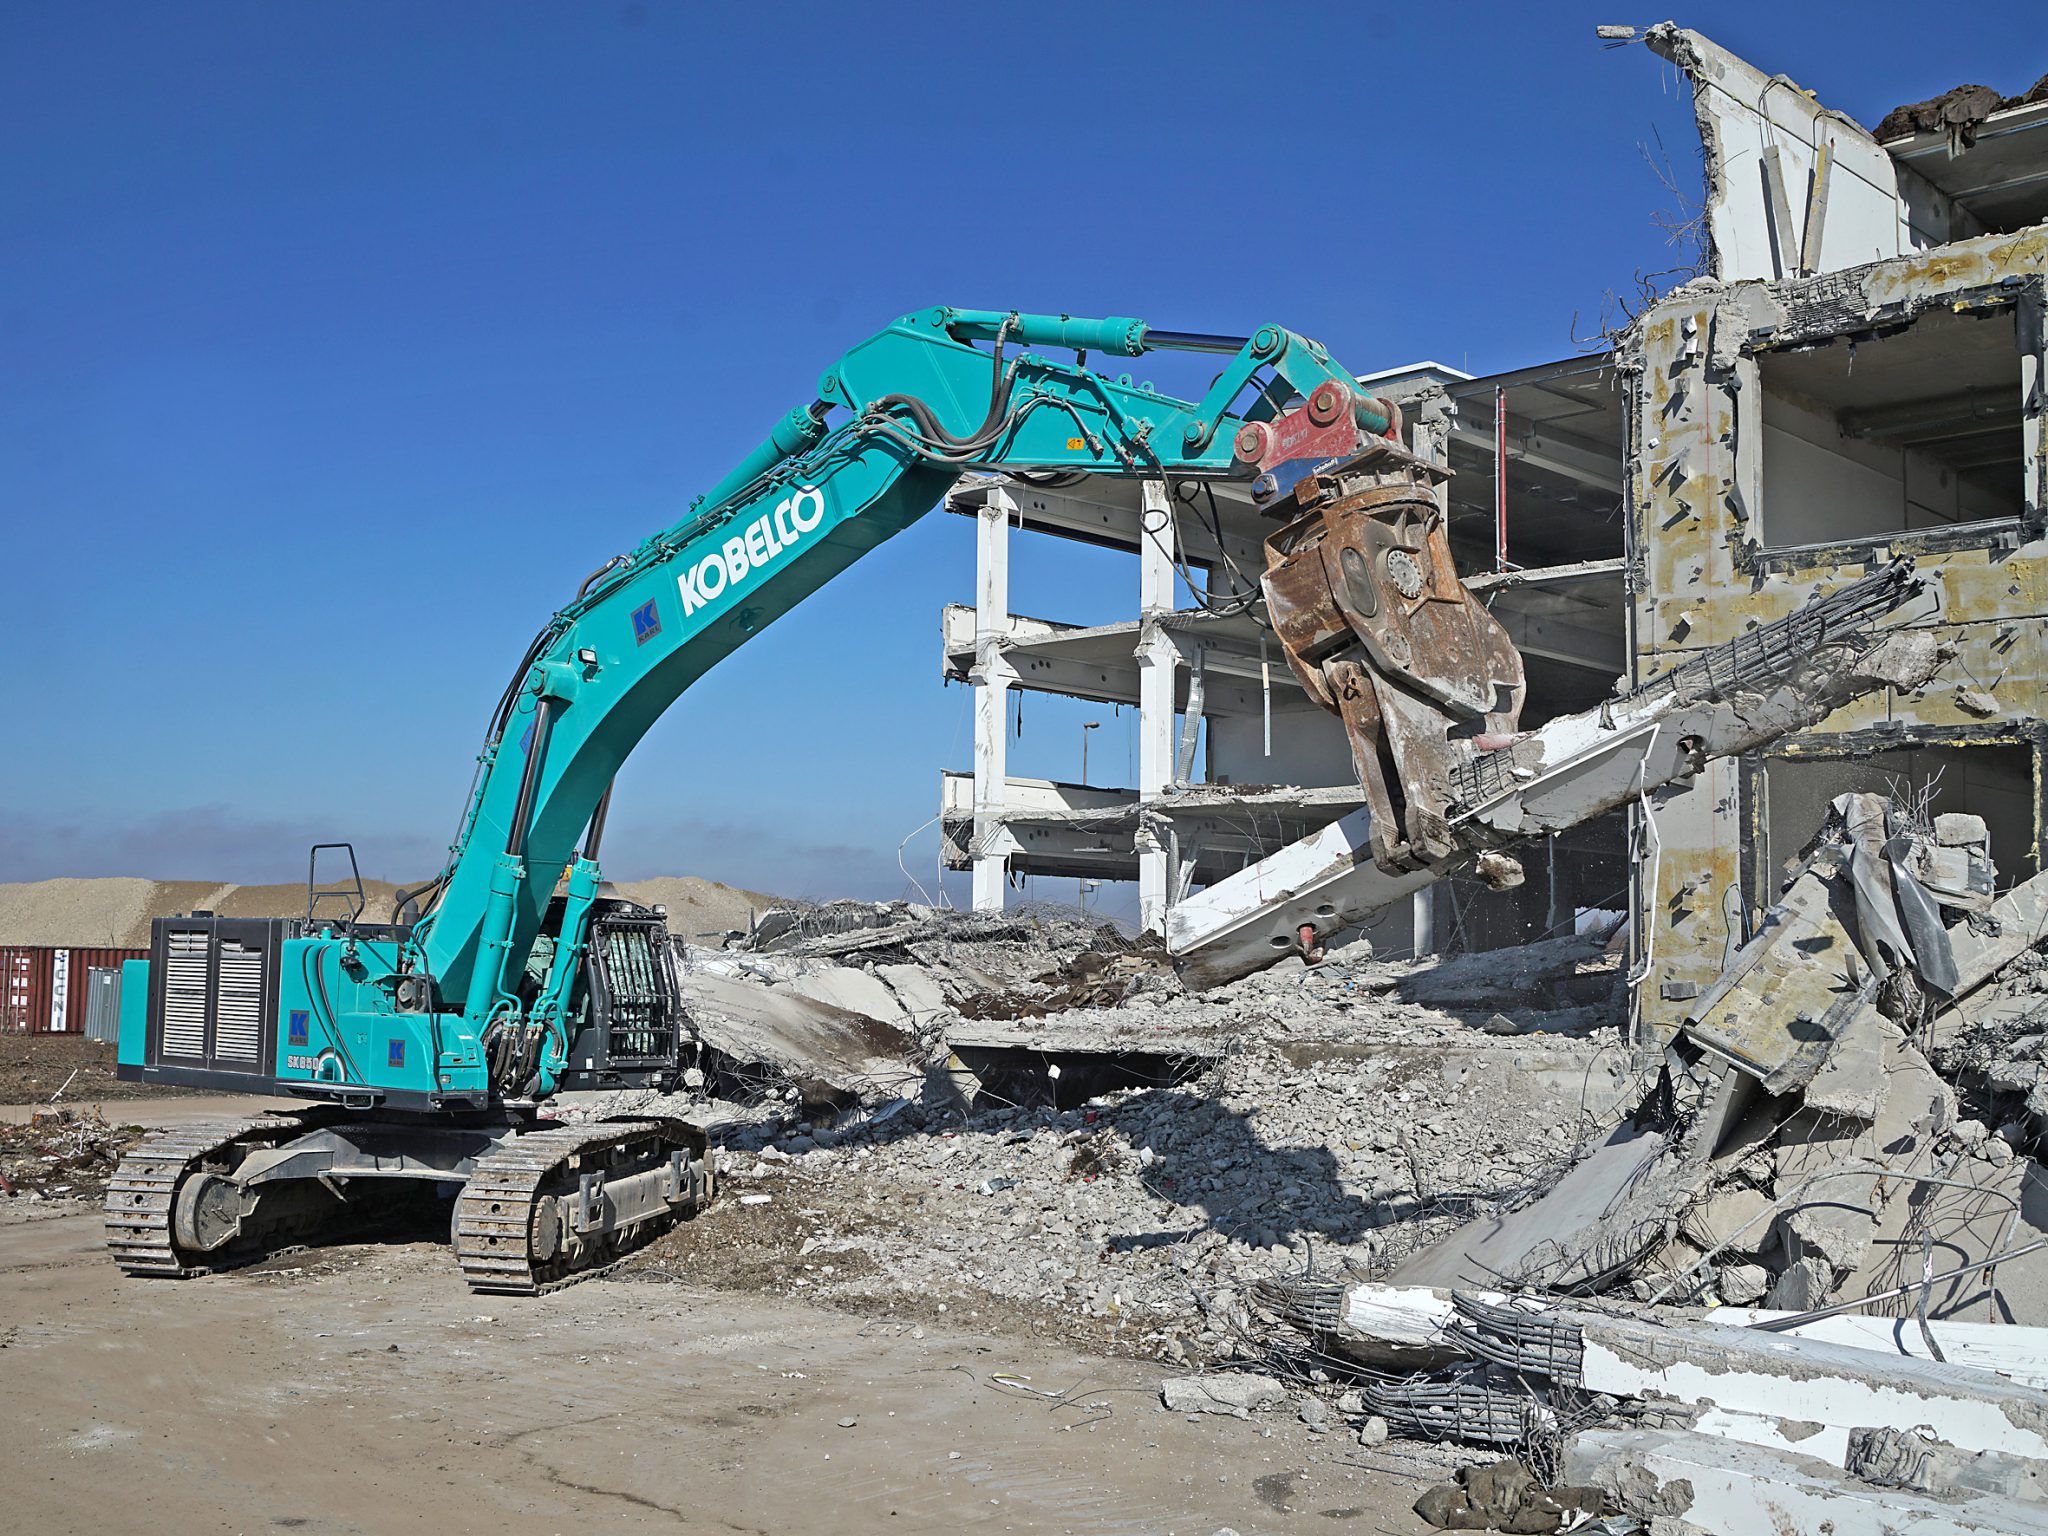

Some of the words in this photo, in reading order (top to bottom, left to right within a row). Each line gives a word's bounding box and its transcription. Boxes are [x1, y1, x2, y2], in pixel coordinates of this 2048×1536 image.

[677, 485, 825, 617] KOBELCO
[634, 603, 657, 636] K
[638, 625, 660, 643] KARL
